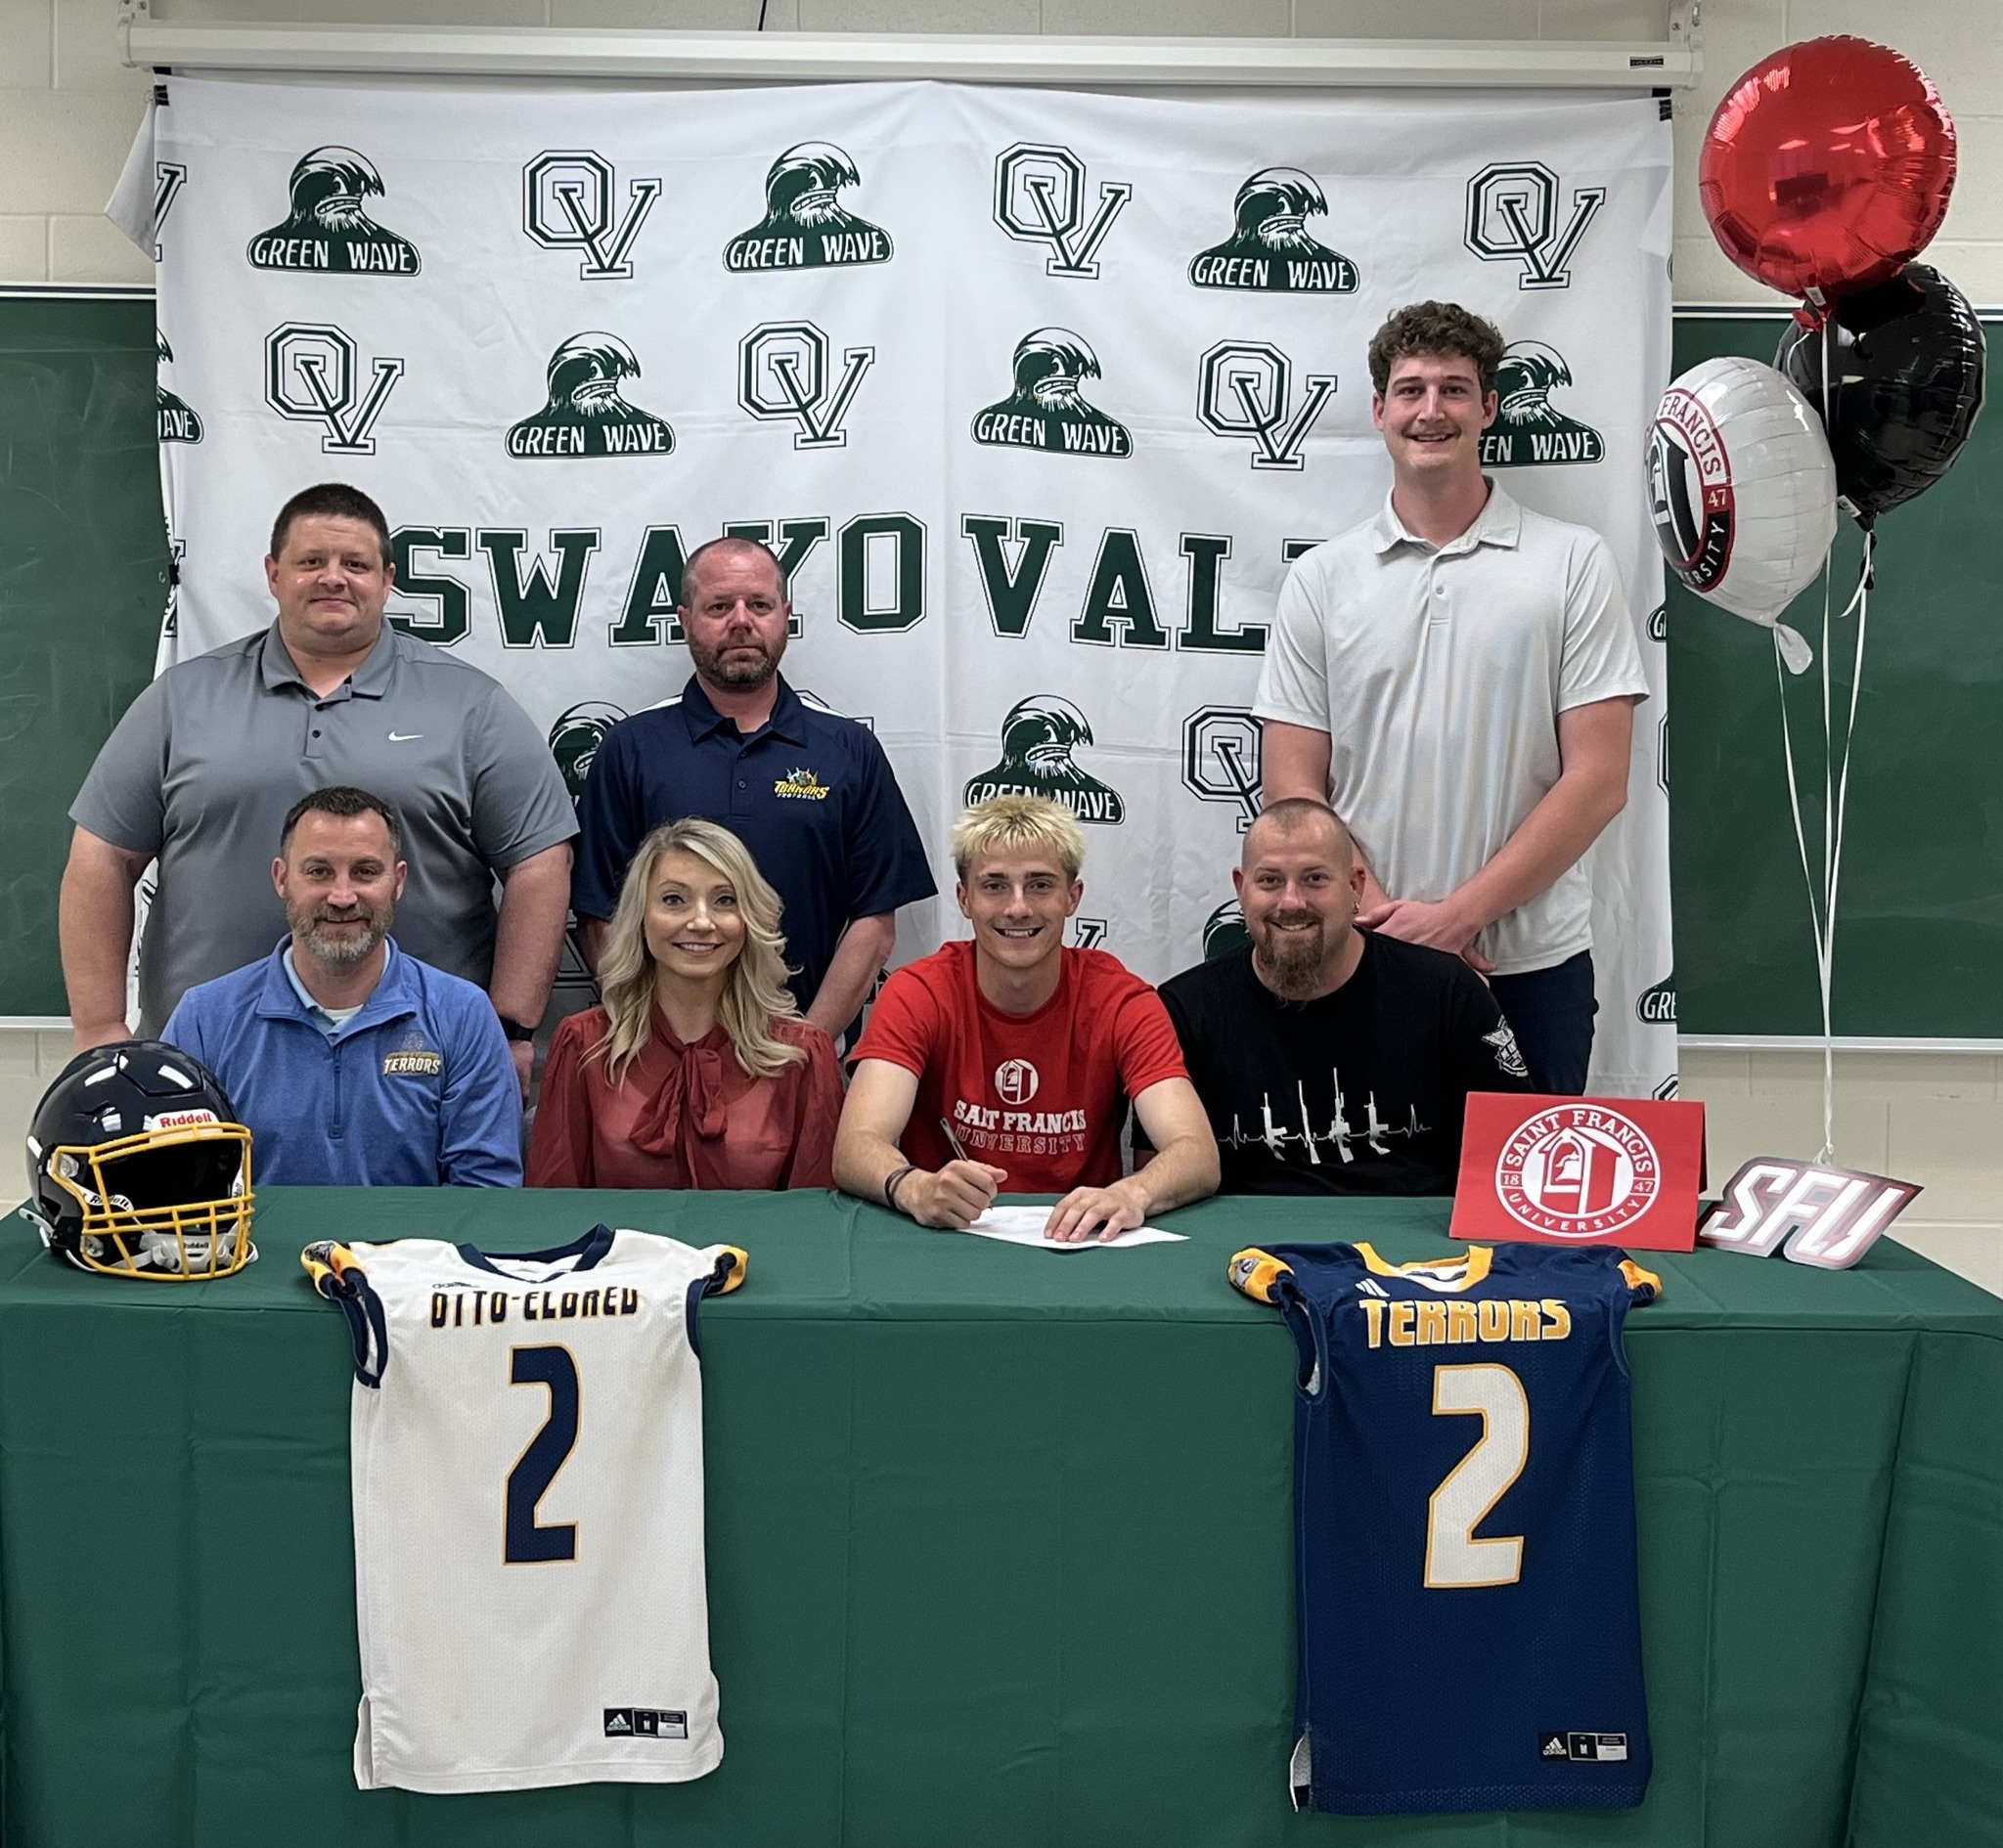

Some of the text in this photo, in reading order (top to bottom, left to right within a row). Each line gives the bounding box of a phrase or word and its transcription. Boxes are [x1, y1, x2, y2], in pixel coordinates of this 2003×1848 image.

[253, 238, 412, 272] GREEN WAVE
[729, 231, 885, 269] GREEN WAVE
[1193, 255, 1351, 290] GREEN WAVE
[157, 409, 195, 440] AVE
[512, 422, 667, 455] GREEN WAVE
[977, 412, 1124, 455] GREEN WAVE
[1660, 396, 1721, 476] FRANCIS
[1530, 431, 1595, 461] WAVE
[1708, 489, 1726, 506] 47
[960, 513, 1325, 656] VAL
[382, 1057, 442, 1076] TERRORS
[159, 1112, 212, 1128] Riddell
[1002, 1109, 1087, 1134] FRANCIS
[1505, 1109, 1653, 1173] SAINT FRANCIS
[1502, 1173, 1520, 1186] 18
[1634, 1180, 1654, 1193] 47
[1508, 1192, 1641, 1232] UNIVERSITY
[1699, 1164, 1906, 1259] SFU
[1358, 1298, 1571, 1348] TERRORS
[503, 1342, 583, 1565] 2
[1424, 1361, 1530, 1588] 2
